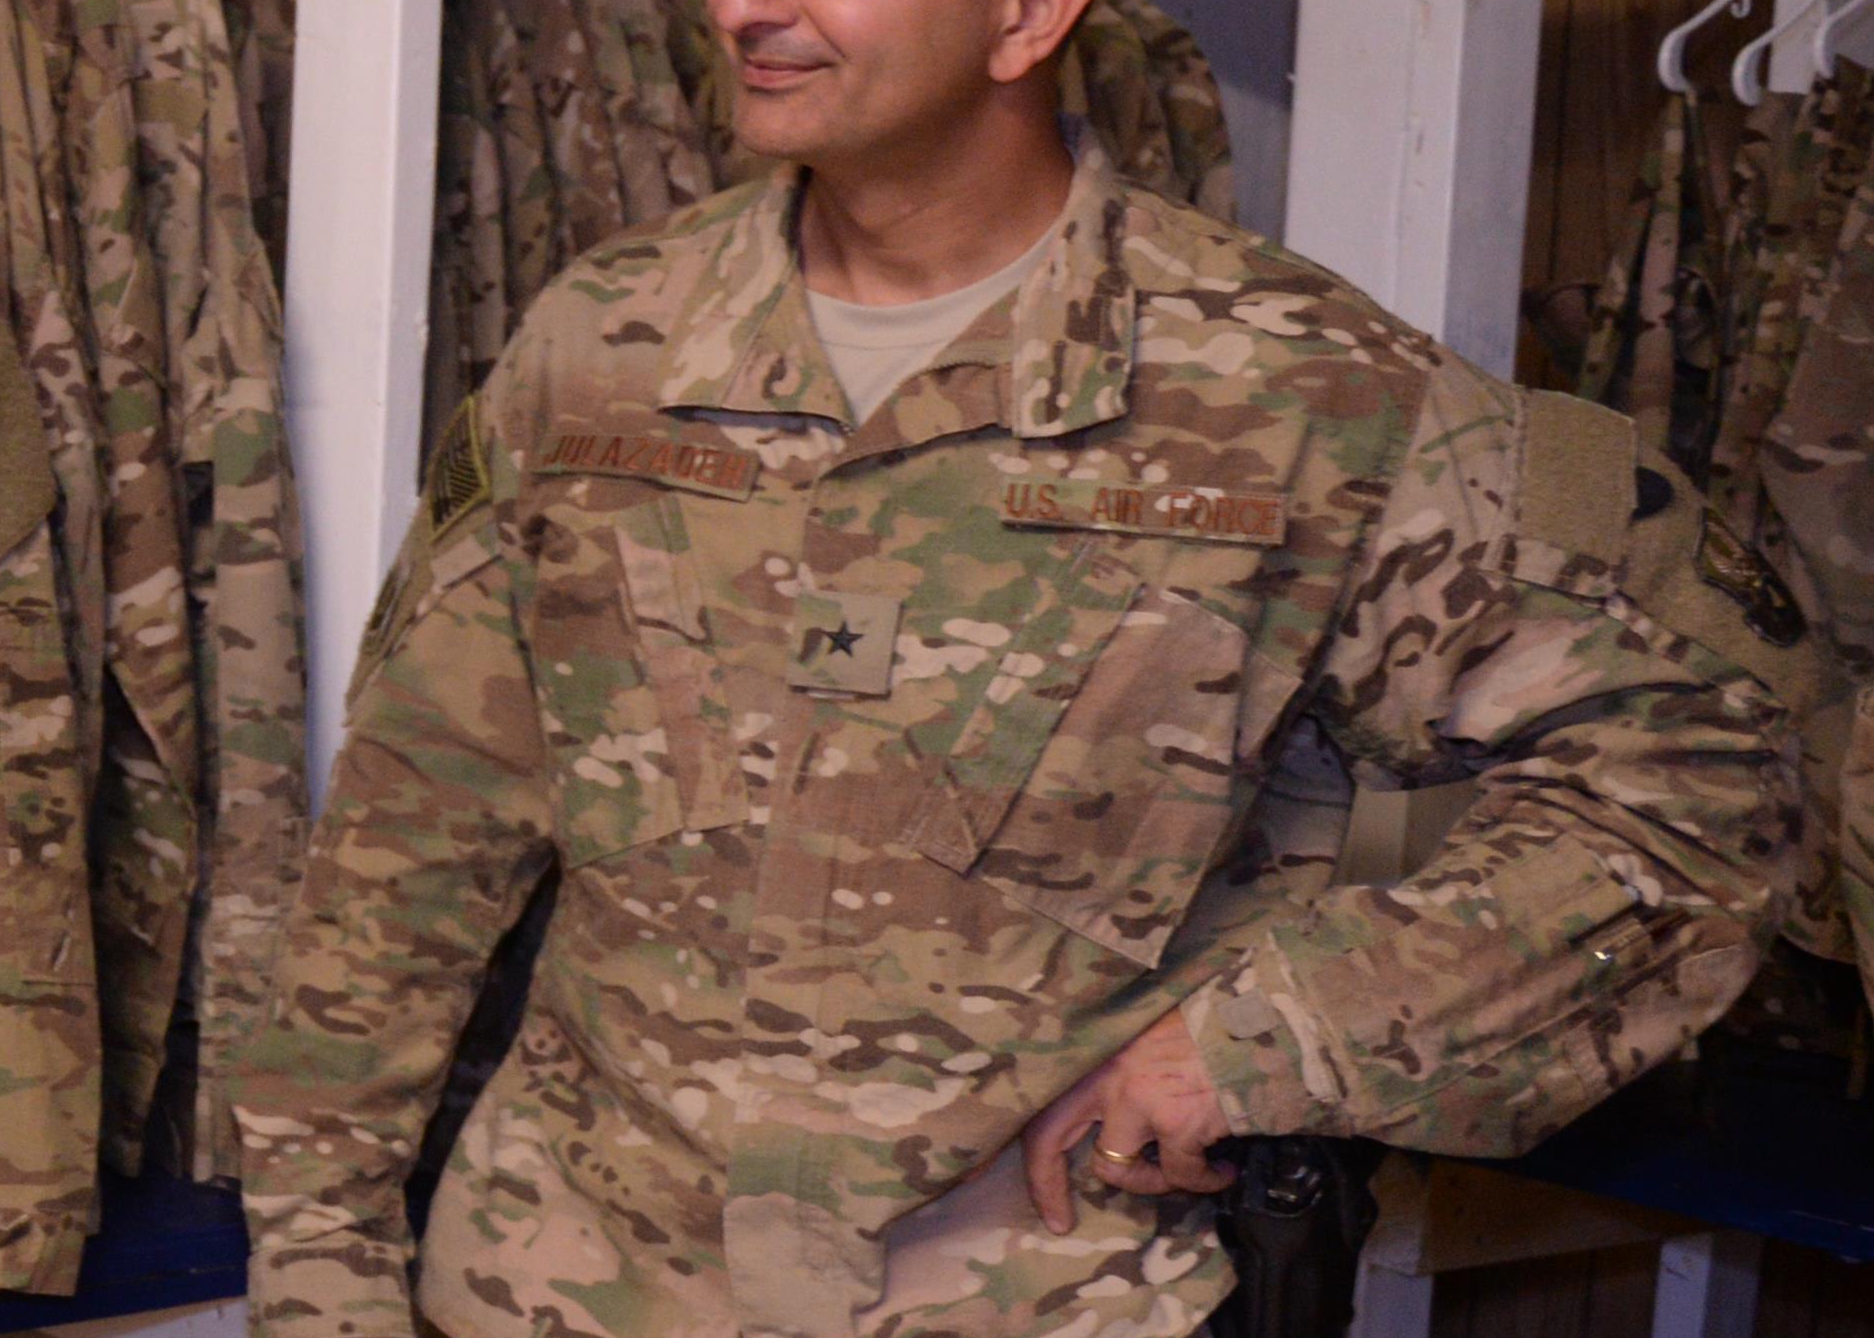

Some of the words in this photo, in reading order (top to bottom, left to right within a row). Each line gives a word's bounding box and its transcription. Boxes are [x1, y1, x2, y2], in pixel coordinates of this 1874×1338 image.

[543, 434, 747, 490] JULAZADEH
[1090, 486, 1145, 526] AIR
[1165, 491, 1279, 536] FORCE
